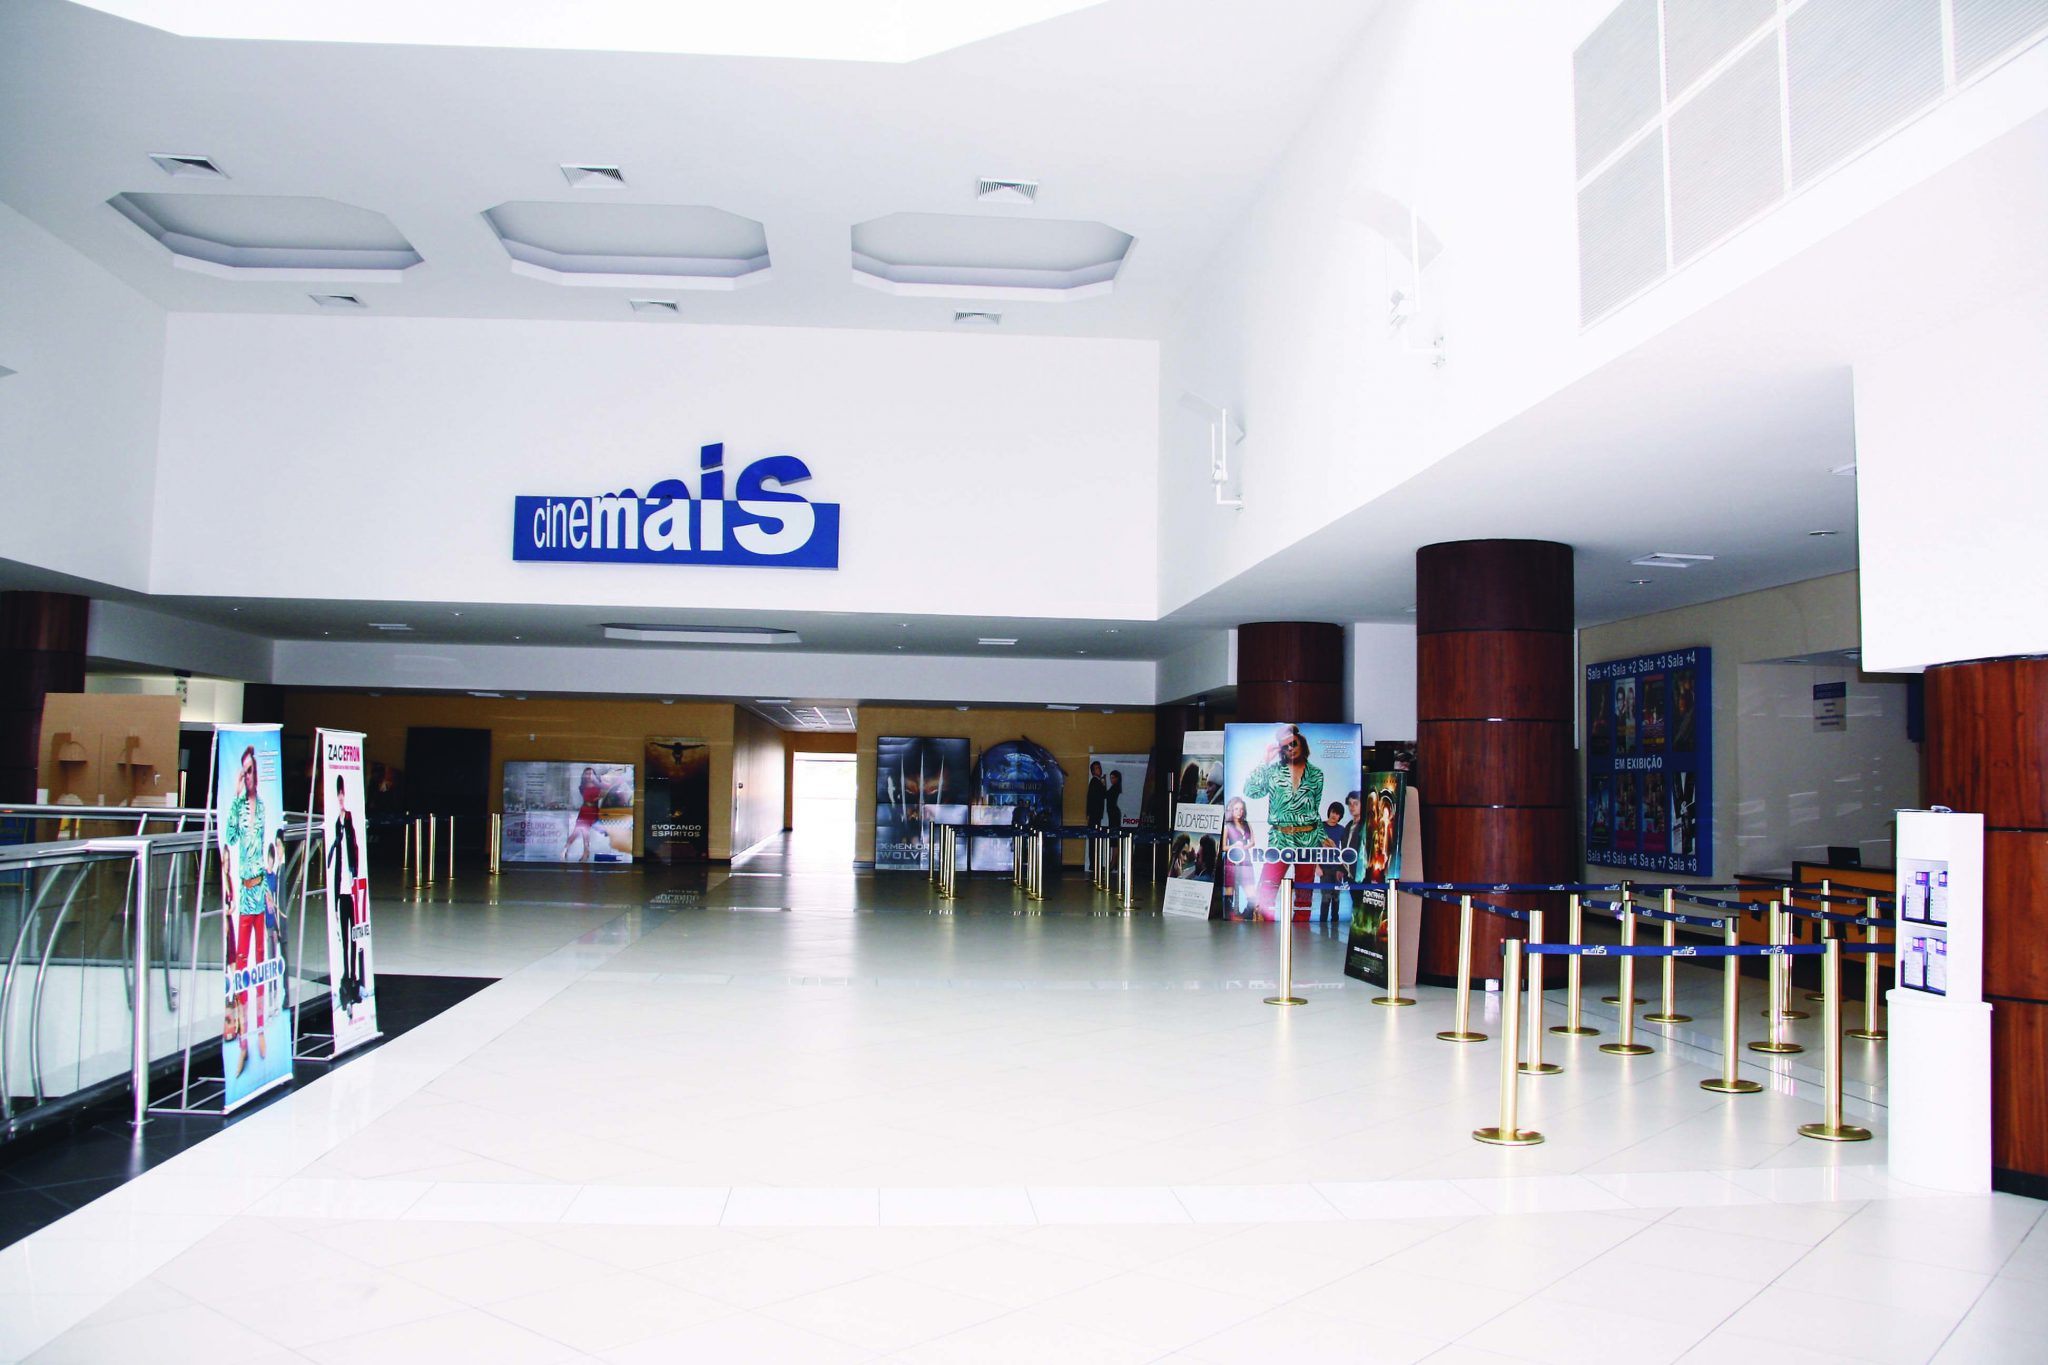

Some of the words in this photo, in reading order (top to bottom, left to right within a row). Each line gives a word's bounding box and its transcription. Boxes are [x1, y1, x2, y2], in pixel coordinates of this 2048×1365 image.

[533, 442, 816, 555] cinemais
[1587, 668, 1601, 681] Sala
[1602, 665, 1611, 678] +1
[1612, 664, 1626, 677] Sala
[1628, 661, 1637, 674] +2
[1639, 659, 1654, 672] Sala
[1657, 655, 1666, 669] +3
[1668, 653, 1684, 668] Sala
[1686, 650, 1696, 665] +4
[1615, 758, 1625, 770] EM
[1627, 755, 1663, 772] EXIBIÇÃO
[1177, 811, 1220, 830] BUDAPESTE
[1228, 847, 1245, 864] O
[1252, 847, 1358, 864] ROQUEIRO
[1587, 850, 1601, 862] Sala
[1603, 851, 1611, 864] +5
[1612, 852, 1627, 865] Sala
[1629, 853, 1637, 866] +6
[1657, 856, 1666, 870] +7
[1668, 857, 1685, 871] Sala
[1688, 858, 1697, 872] +8
[351, 878, 367, 925] 17
[234, 957, 285, 992] ROQUEIRO
